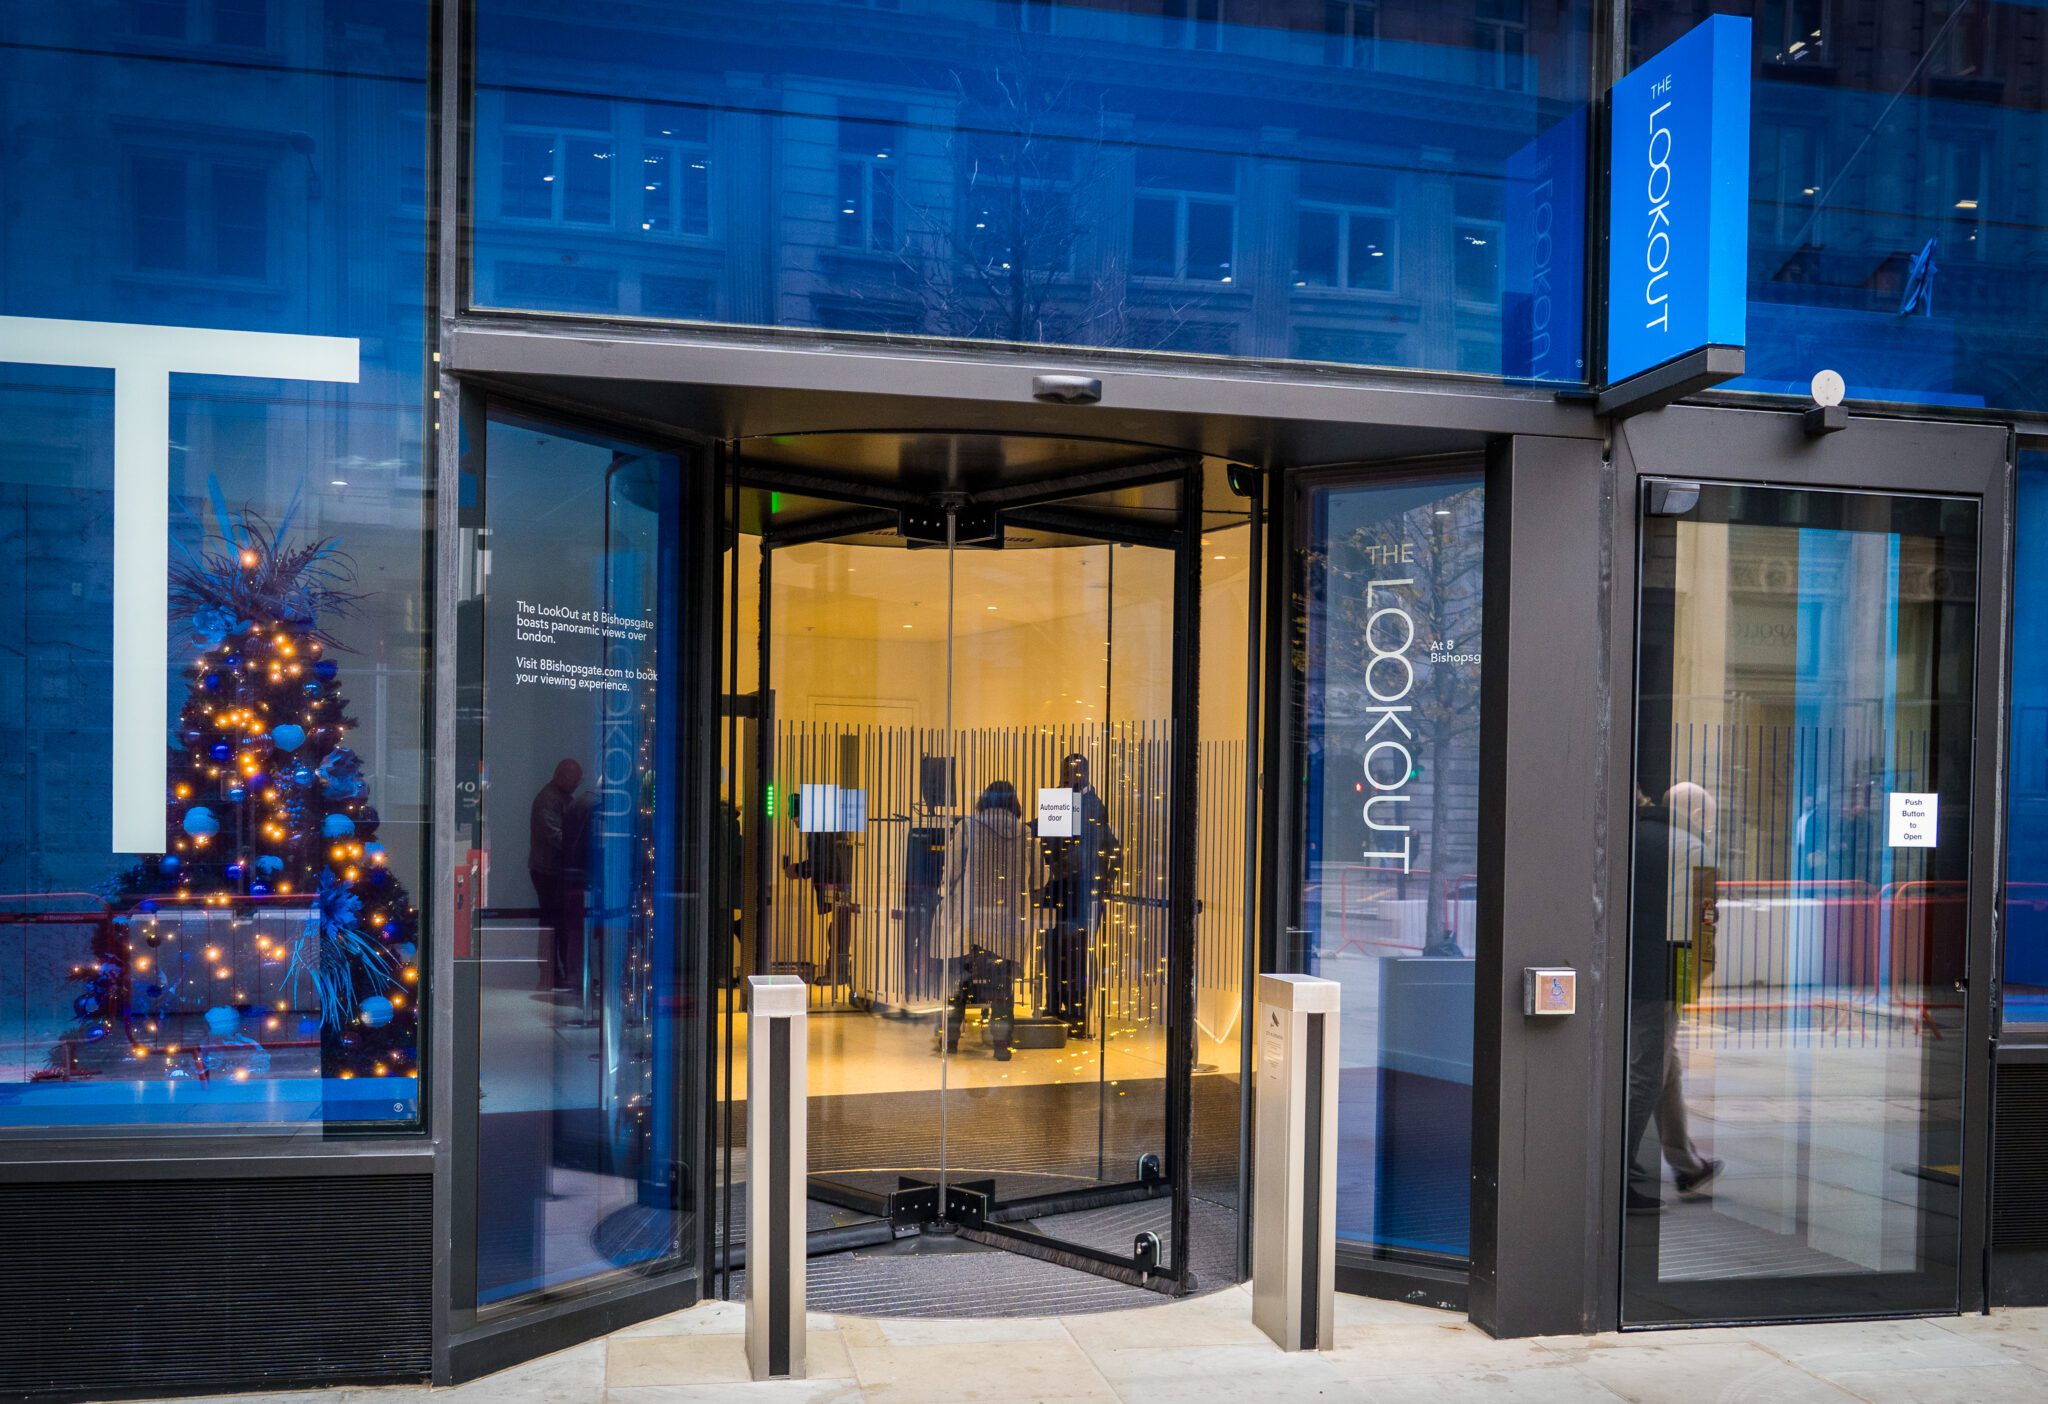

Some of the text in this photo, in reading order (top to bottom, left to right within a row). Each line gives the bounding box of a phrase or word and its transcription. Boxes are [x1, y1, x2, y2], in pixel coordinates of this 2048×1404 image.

[1650, 74, 1672, 100] THE
[1646, 101, 1672, 332] LOOKOUT
[1366, 542, 1414, 565] THE
[0, 315, 361, 856] T
[517, 600, 654, 630] The LookOut at 8 Bishopsgate
[516, 614, 647, 641] boasts panoramic views over
[516, 628, 556, 644] London.
[1430, 640, 1454, 651] At 8
[516, 656, 658, 681] Visit 8Bishopsgate.com to book
[516, 672, 630, 692] your viewing experience.
[1363, 578, 1415, 875] LOOKOUT
[1040, 803, 1070, 811] Automatic
[1047, 814, 1062, 822] door
[1903, 833, 1922, 841] Open
